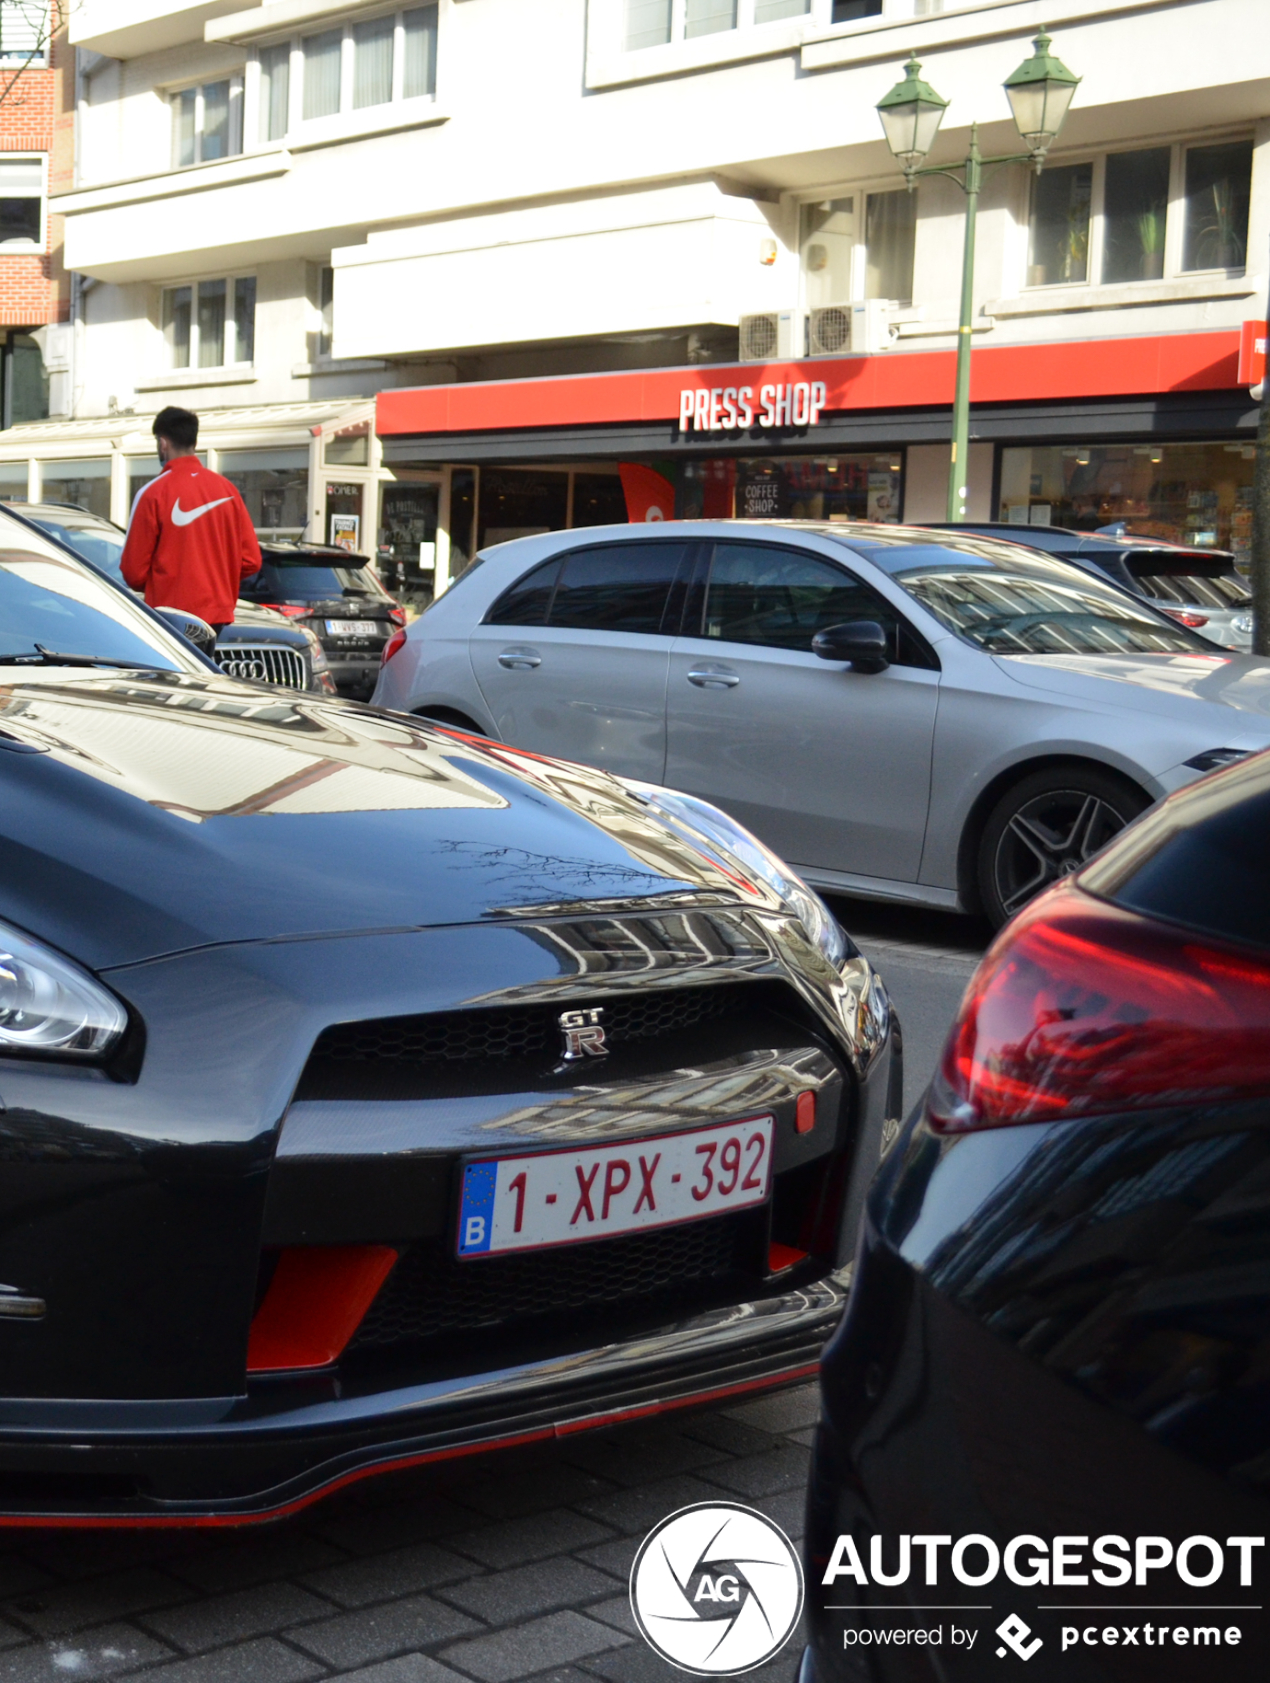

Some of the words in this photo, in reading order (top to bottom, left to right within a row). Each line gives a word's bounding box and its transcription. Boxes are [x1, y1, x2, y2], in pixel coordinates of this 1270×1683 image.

[679, 386, 753, 431] PRESS
[759, 381, 826, 427] SHOP
[745, 485, 778, 498] COFFEE
[748, 499, 774, 513] SHOP
[465, 1216, 485, 1246] B
[509, 1131, 766, 1233] 1-XPX-392
